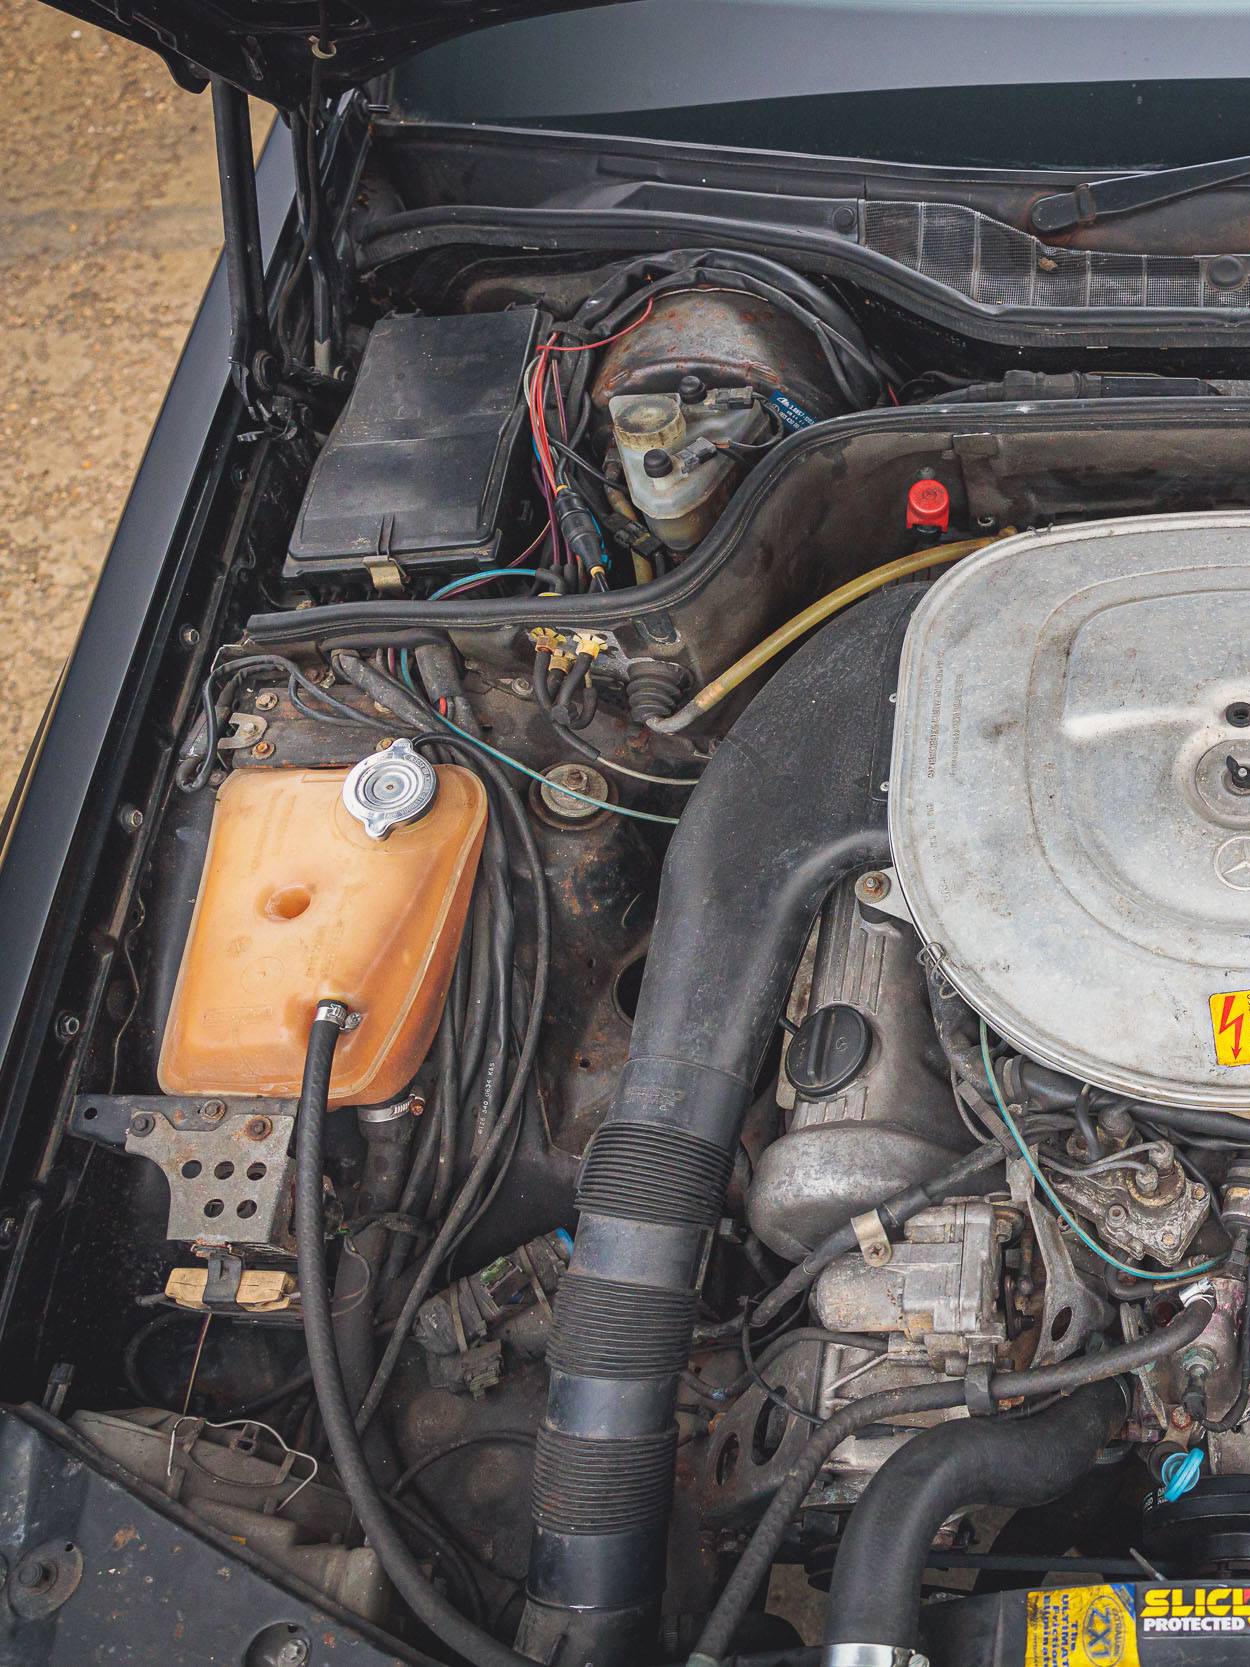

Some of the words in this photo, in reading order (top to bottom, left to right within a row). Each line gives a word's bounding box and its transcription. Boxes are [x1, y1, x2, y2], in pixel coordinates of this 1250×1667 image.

[1070, 1619, 1078, 1651] The
[1087, 1606, 1111, 1658] ZX1
[1144, 1617, 1246, 1632] PROTECTED
